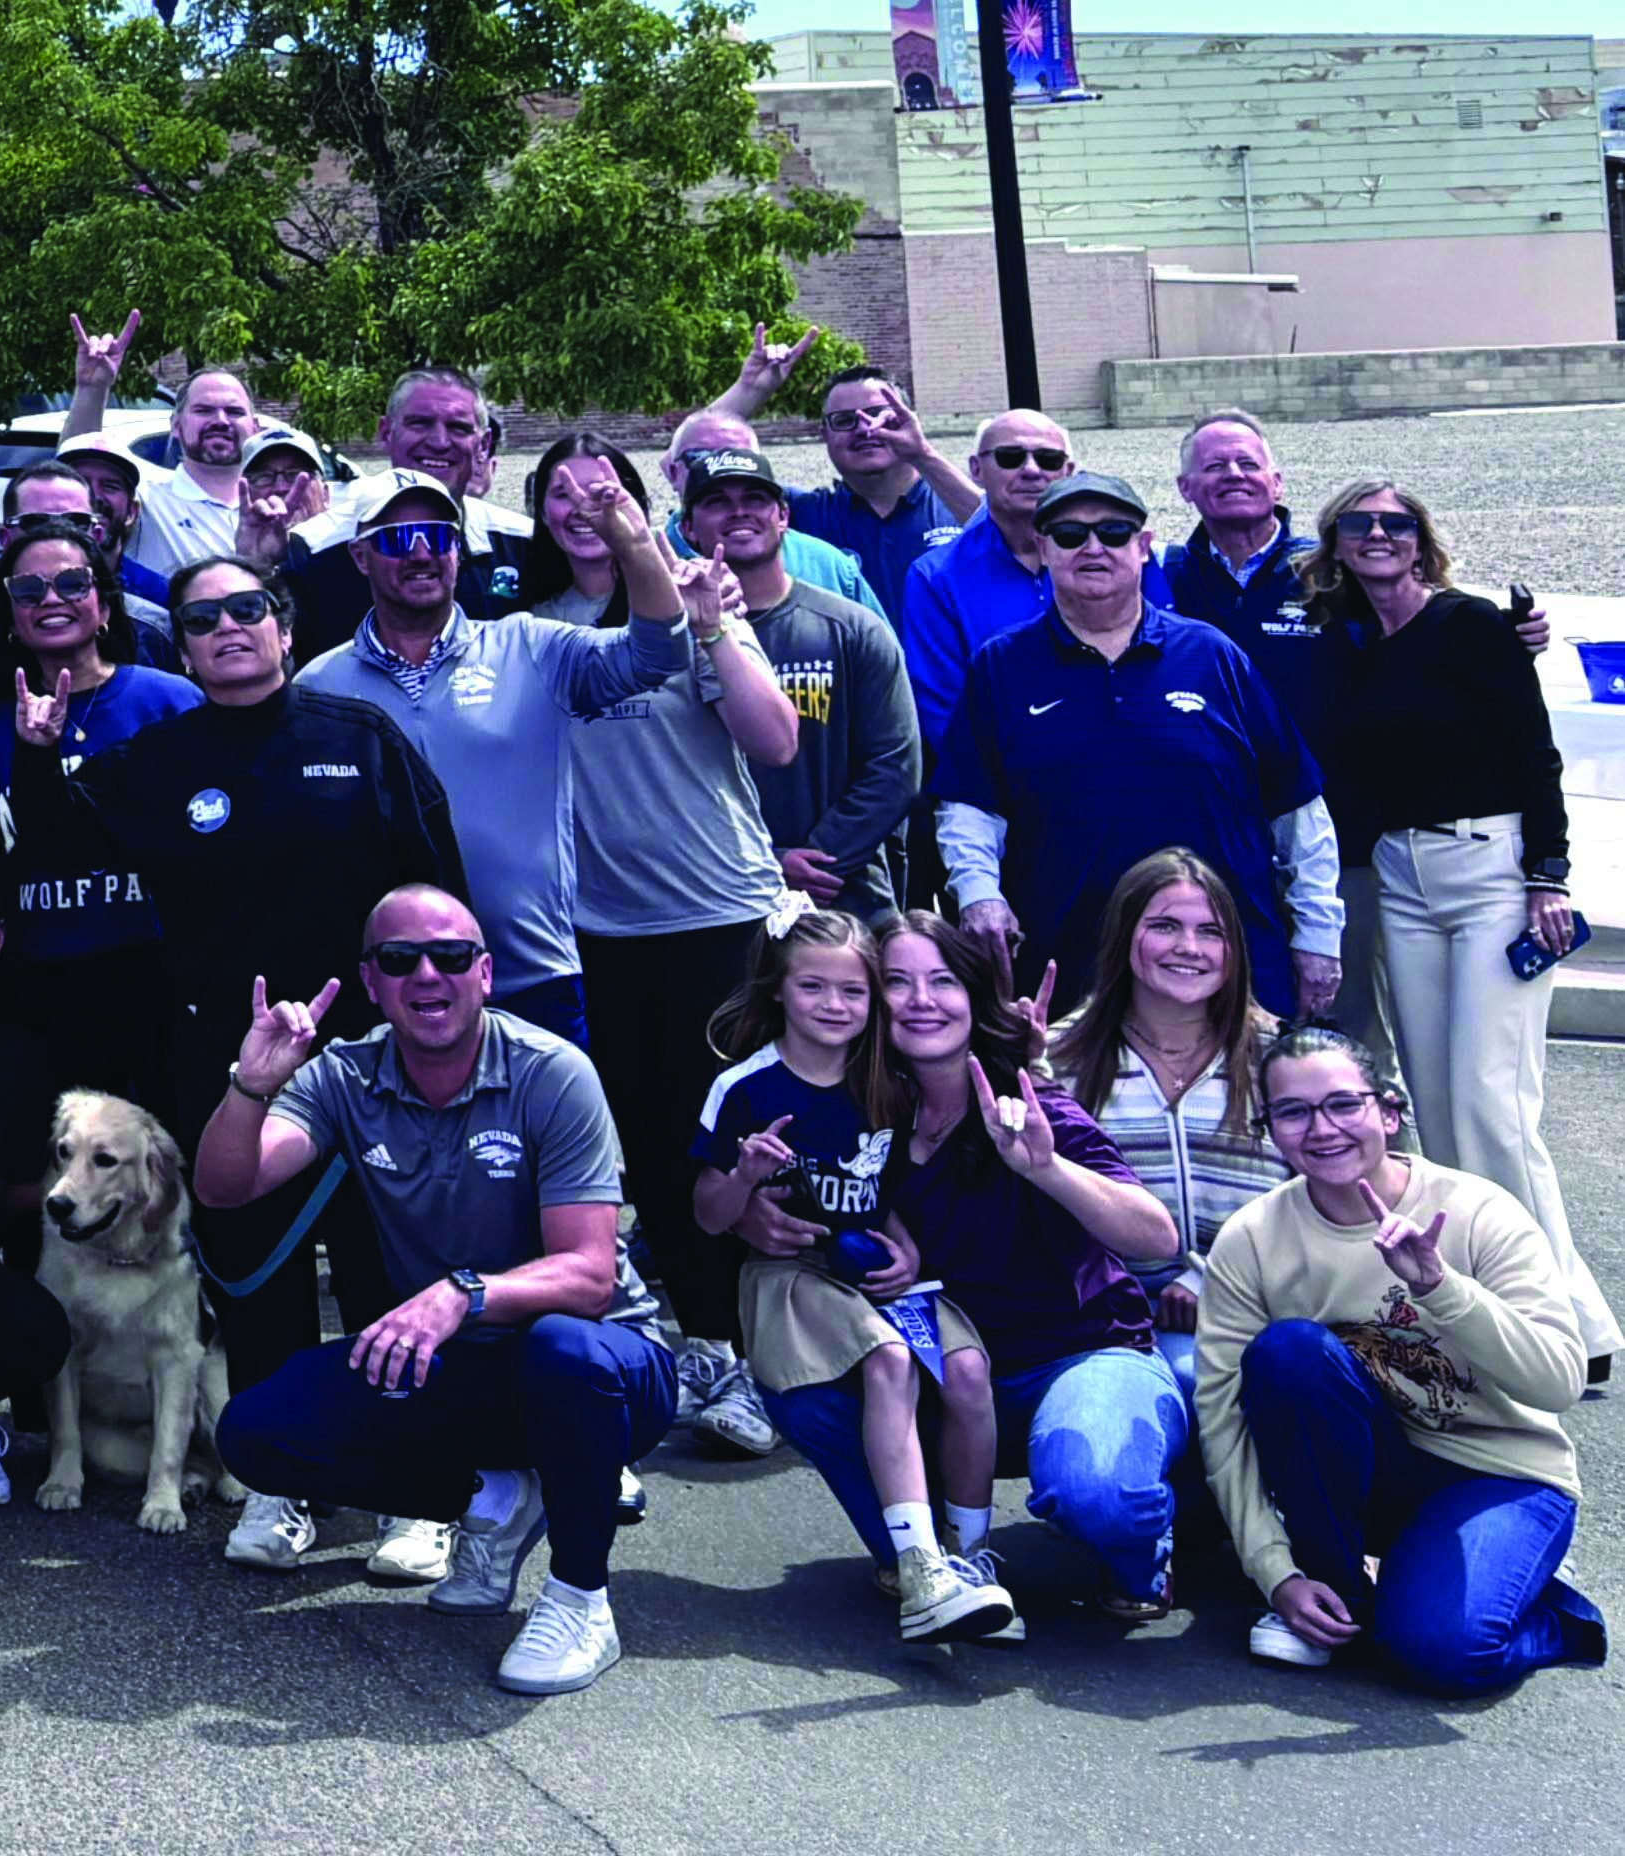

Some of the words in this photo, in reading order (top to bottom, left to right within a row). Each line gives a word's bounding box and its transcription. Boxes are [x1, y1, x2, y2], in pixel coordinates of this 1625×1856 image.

[393, 471, 418, 489] N
[302, 763, 361, 777] NEVADA
[20, 879, 91, 911] WOLF
[468, 1129, 523, 1150] NEVADA
